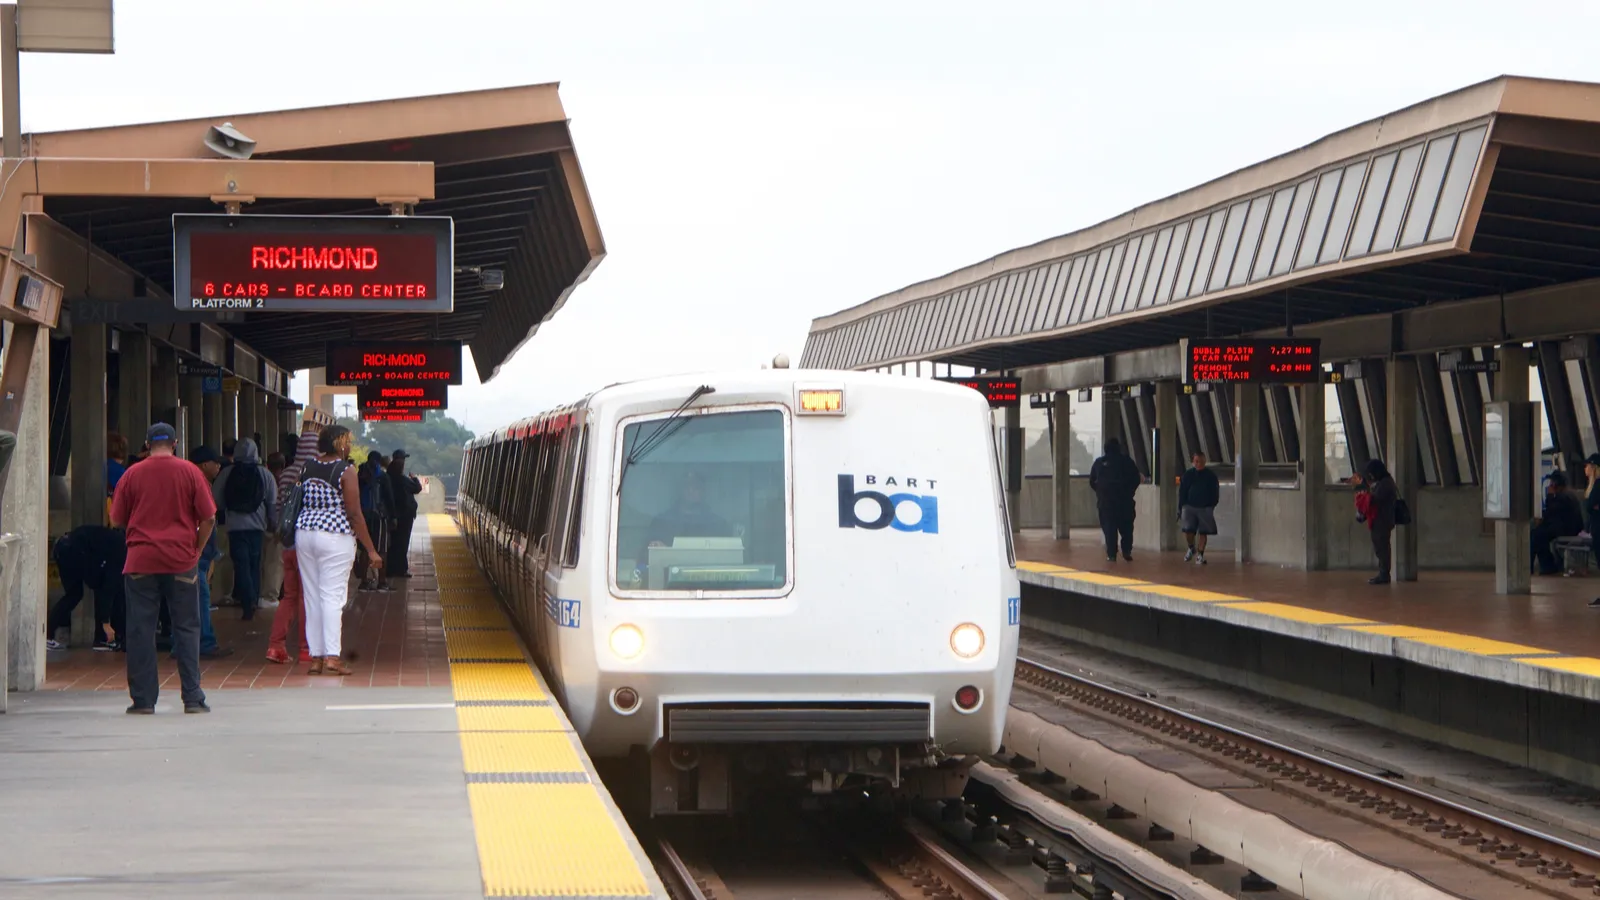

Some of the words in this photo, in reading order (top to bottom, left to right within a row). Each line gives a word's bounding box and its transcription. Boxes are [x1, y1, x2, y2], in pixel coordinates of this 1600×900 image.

[251, 246, 377, 269] RICHMOND
[205, 283, 214, 296] 6
[222, 283, 269, 297] CARS
[361, 284, 427, 298] CENTER
[192, 298, 253, 309] PLATFORM
[256, 298, 264, 309] 2
[363, 354, 426, 366] RICHMOND
[382, 389, 424, 397] RICHMOND
[866, 475, 937, 489] BART
[558, 600, 580, 627] 164
